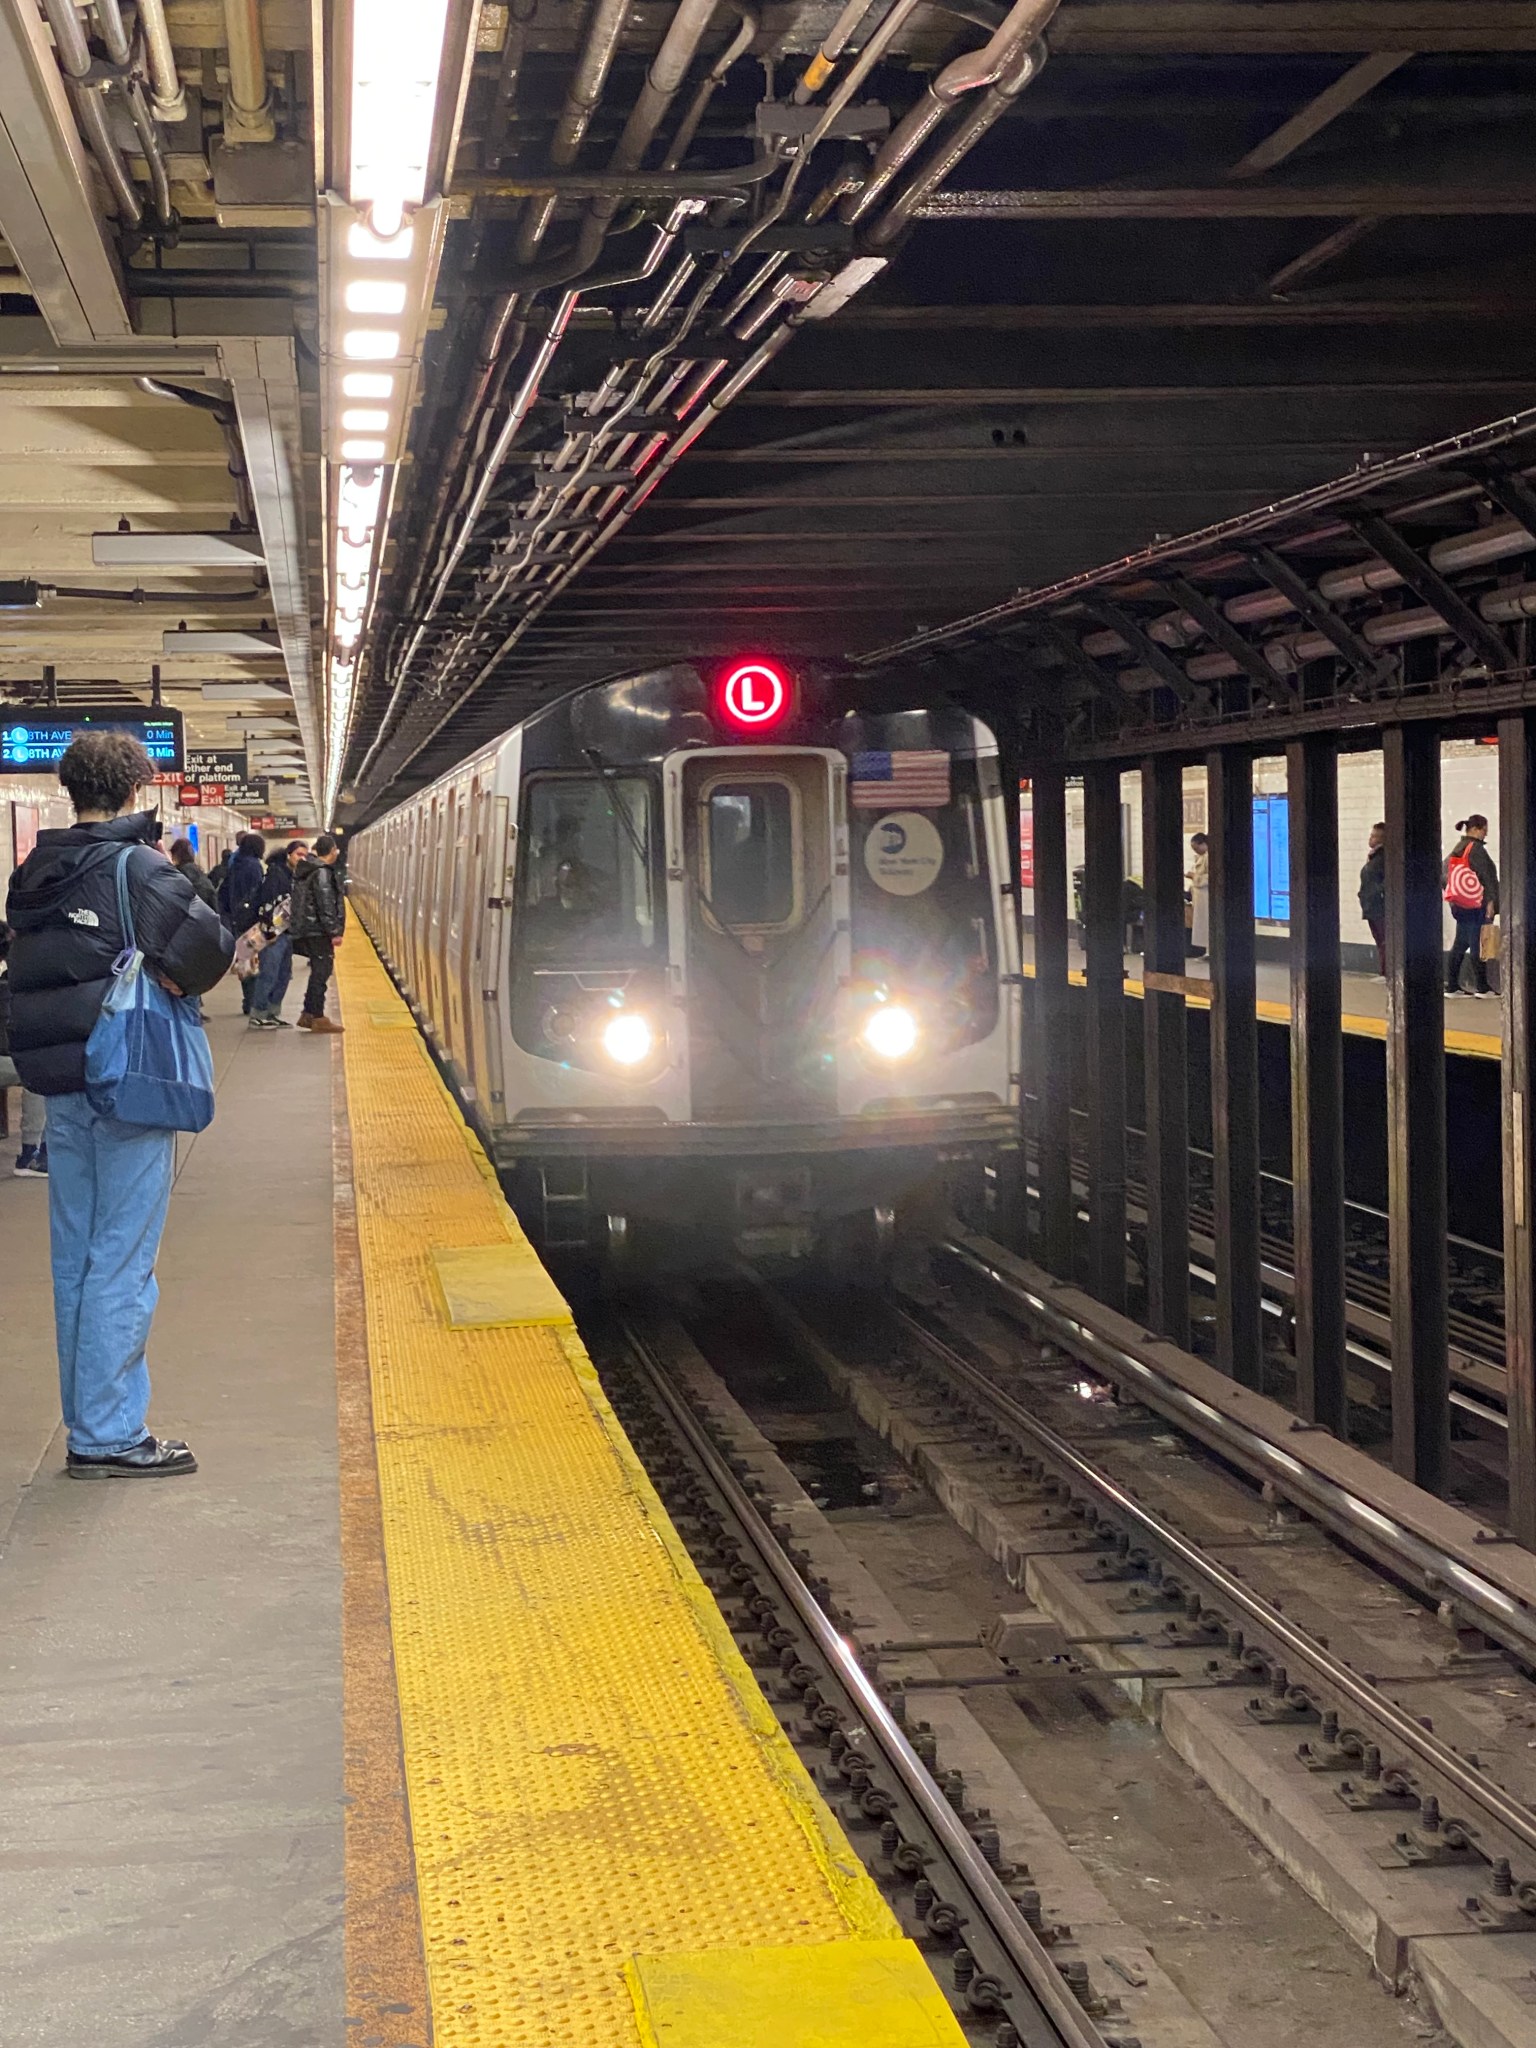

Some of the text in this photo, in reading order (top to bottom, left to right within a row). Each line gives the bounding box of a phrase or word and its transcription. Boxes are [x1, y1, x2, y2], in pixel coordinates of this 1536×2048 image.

[741, 677, 765, 711] L
[51, 731, 72, 740] AVE
[147, 730, 153, 739] 0
[156, 730, 174, 739] Min
[29, 748, 49, 759] 8TH
[156, 747, 175, 757] Min
[186, 755, 217, 764] Exit at
[185, 763, 234, 773] other end
[184, 773, 241, 784] of platform
[201, 785, 217, 795] No
[201, 795, 224, 805] Exit
